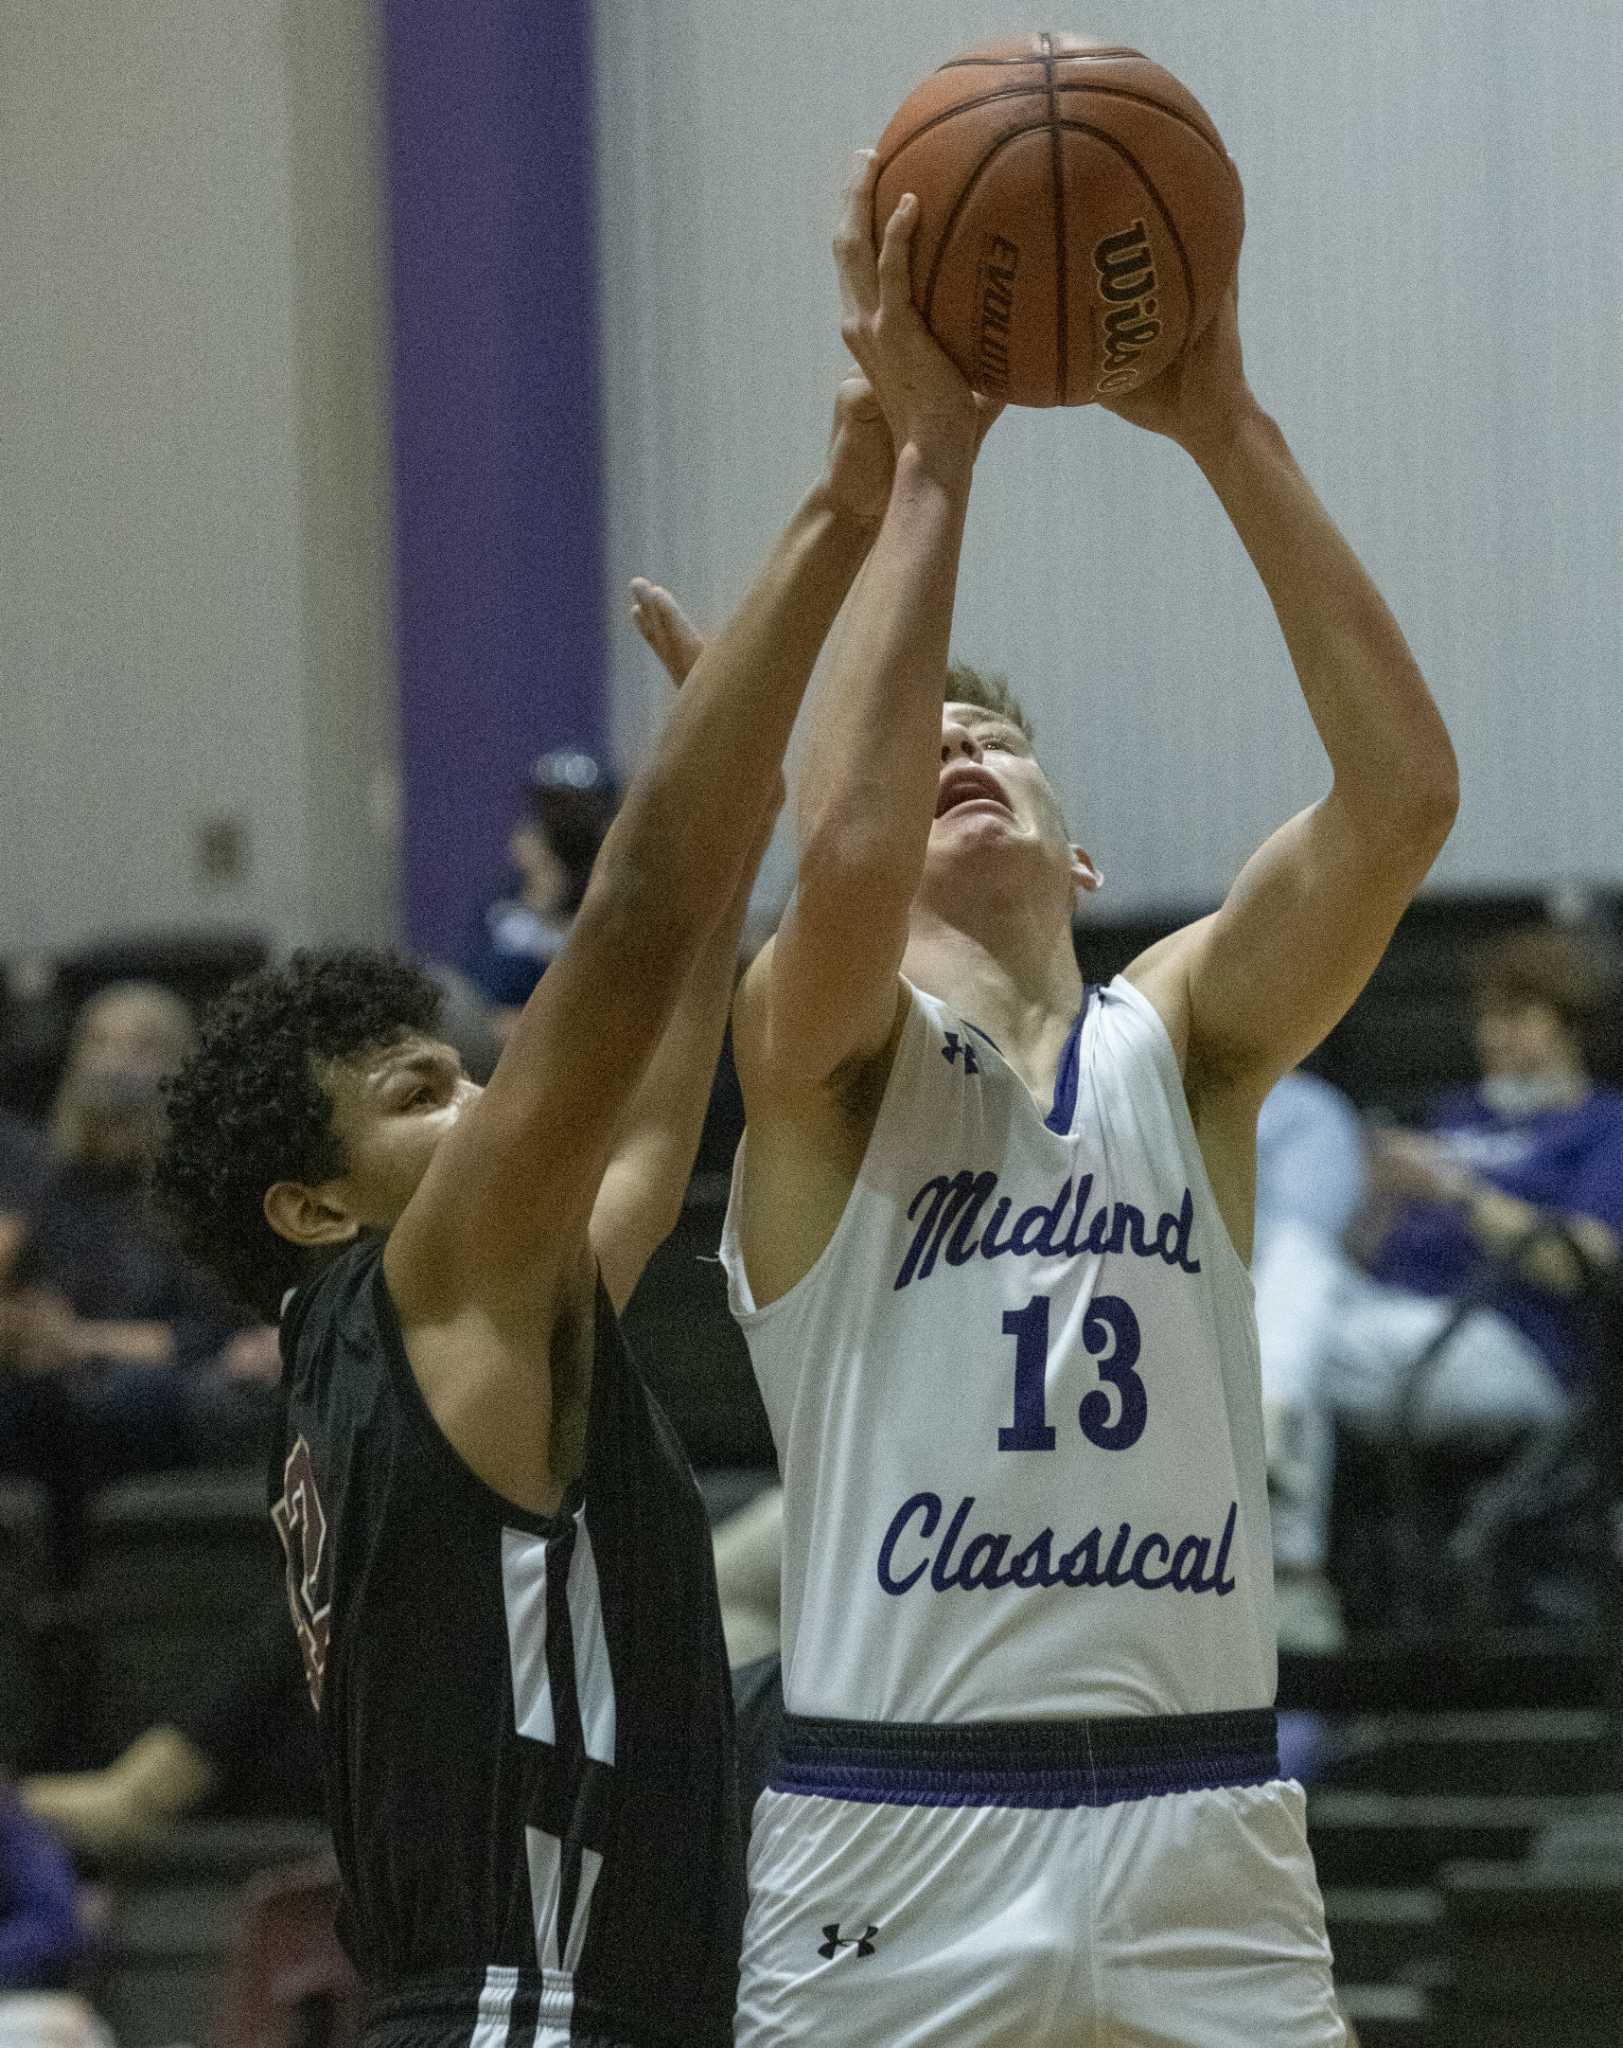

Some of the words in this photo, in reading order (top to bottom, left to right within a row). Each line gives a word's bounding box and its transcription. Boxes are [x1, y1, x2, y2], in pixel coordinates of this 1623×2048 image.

[1092, 217, 1161, 398] Wilso
[997, 1295, 1148, 1452] 13
[876, 1491, 1238, 1597] Classical
